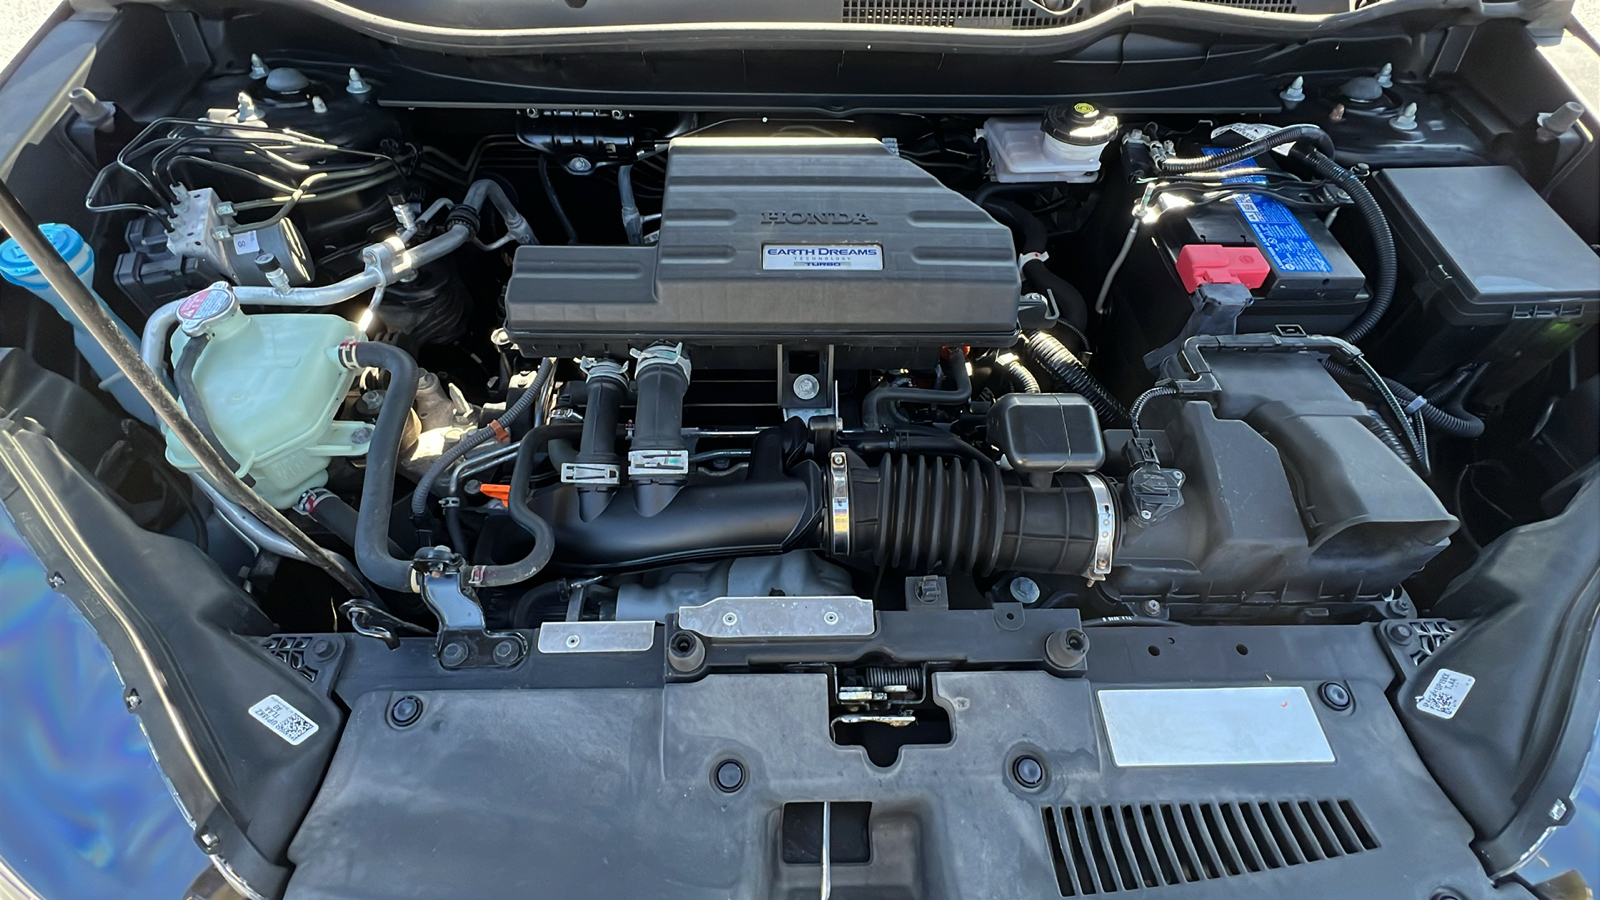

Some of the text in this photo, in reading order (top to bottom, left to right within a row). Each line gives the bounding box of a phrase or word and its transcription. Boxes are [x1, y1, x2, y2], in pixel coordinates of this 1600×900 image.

[760, 211, 878, 225] HONDA
[767, 247, 877, 256] EARTH DREAMS
